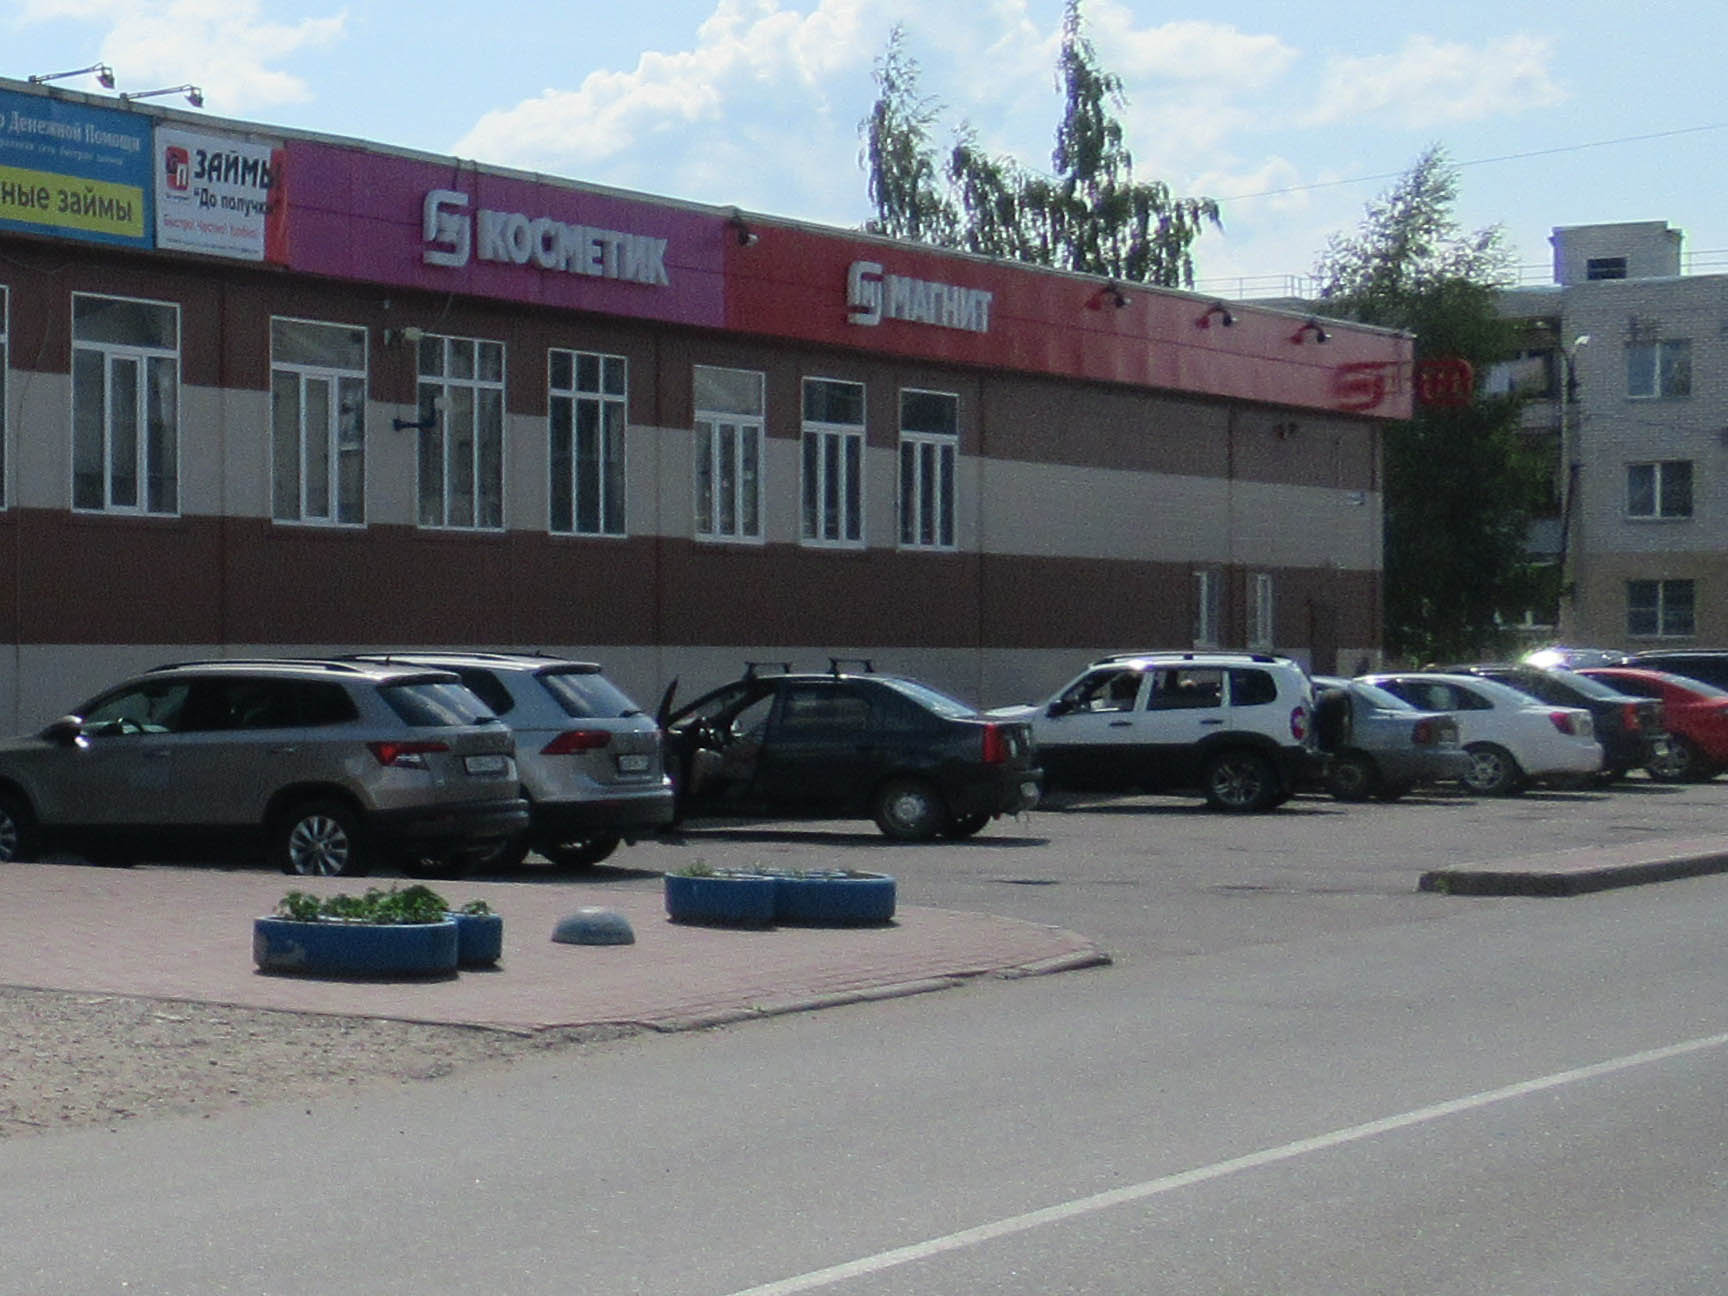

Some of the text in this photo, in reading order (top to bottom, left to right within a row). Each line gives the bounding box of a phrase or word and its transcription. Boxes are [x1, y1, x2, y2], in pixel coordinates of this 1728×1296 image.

[9, 111, 82, 143] Денежной
[85, 124, 141, 153] Помощи
[58, 186, 132, 222] займы
[477, 209, 670, 287] КОСМЕТИК
[884, 274, 993, 334] МАГНИТ
